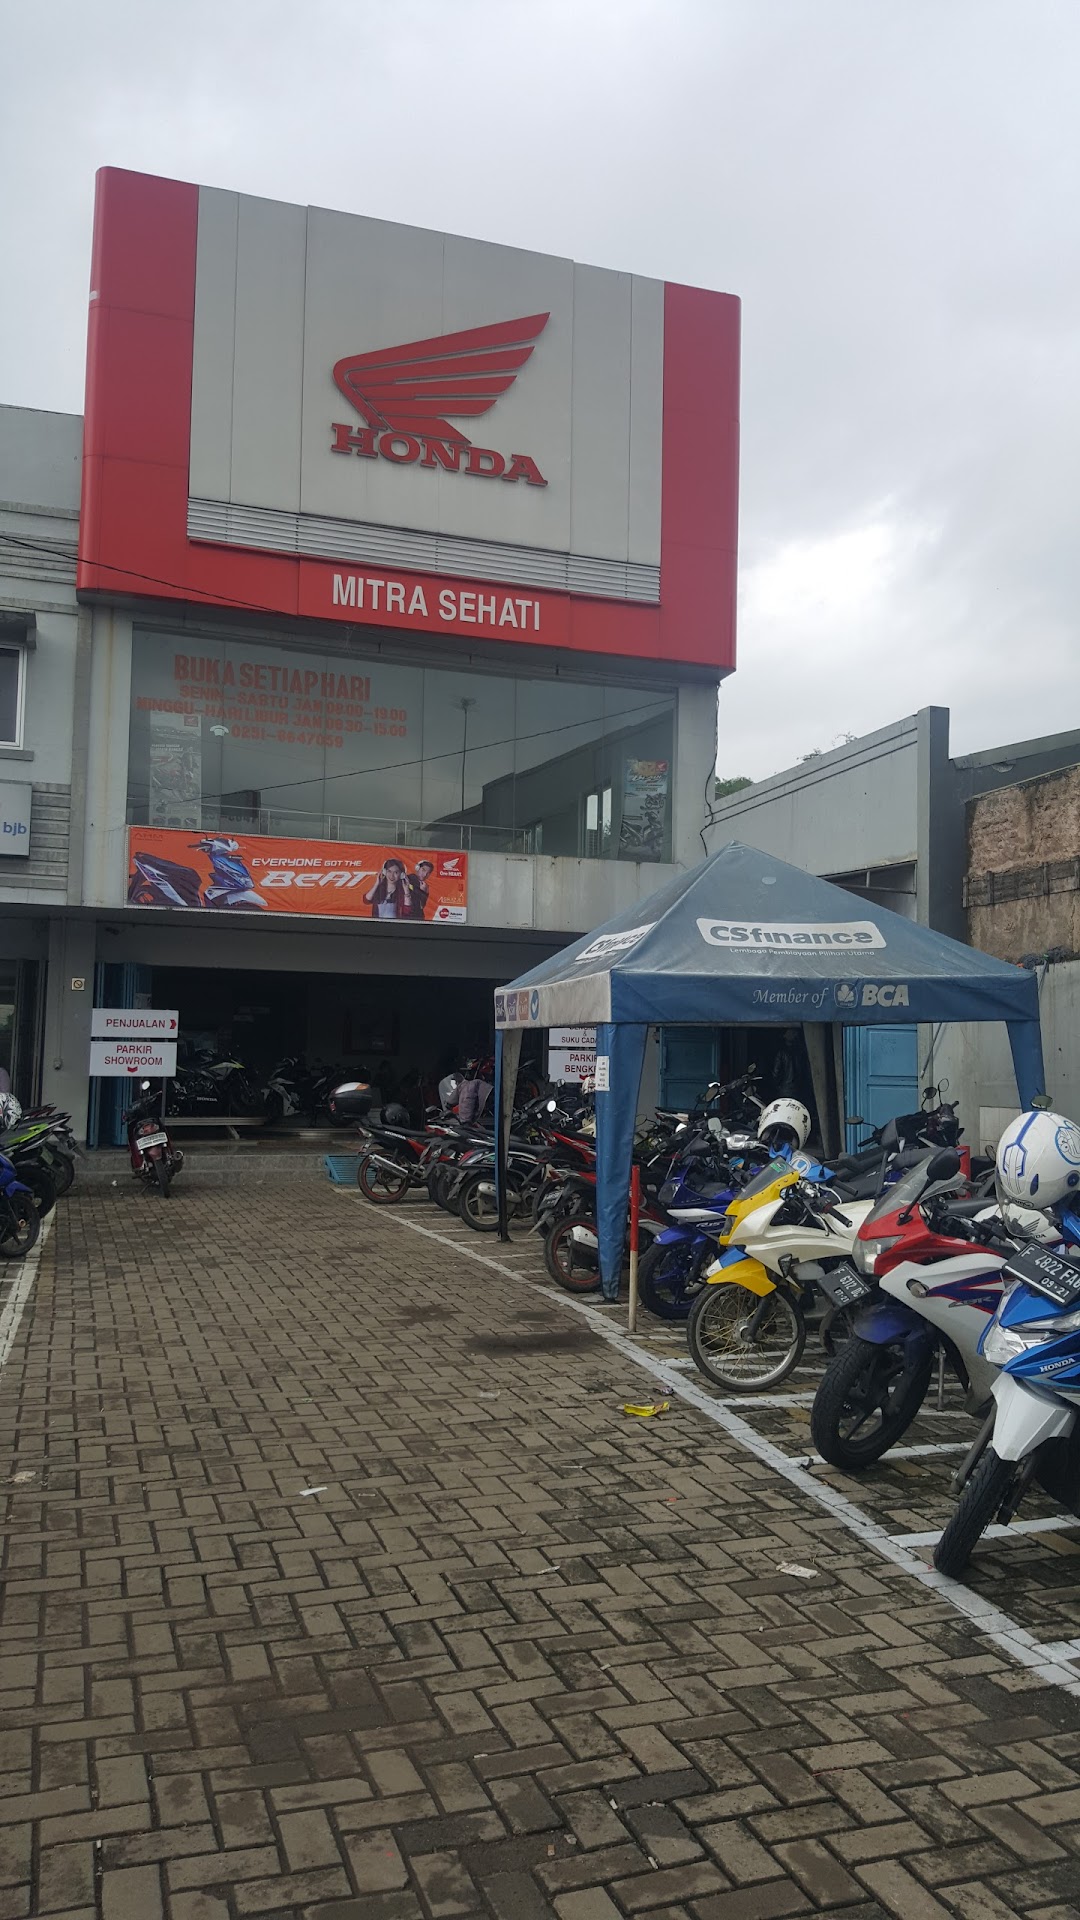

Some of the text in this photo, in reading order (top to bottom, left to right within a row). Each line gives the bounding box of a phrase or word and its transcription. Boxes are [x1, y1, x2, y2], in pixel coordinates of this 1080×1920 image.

[331, 423, 548, 487] HONDA
[332, 574, 540, 631] MITRA SEHATI
[175, 654, 371, 702] BUKA SETIAP HARI
[3, 821, 27, 836] bjb
[252, 858, 322, 867] EVERYONE
[710, 925, 873, 944] CSfinance
[752, 984, 910, 1009] Member of BCA
[106, 1018, 165, 1028] PENJUALAN
[116, 1045, 152, 1054] PARKIR
[104, 1056, 163, 1066] SHOWROOM
[1020, 1245, 1035, 1257] F
[1034, 1254, 1064, 1276] 4822
[832, 1268, 846, 1276] F
[1039, 1357, 1076, 1373] HONDA
